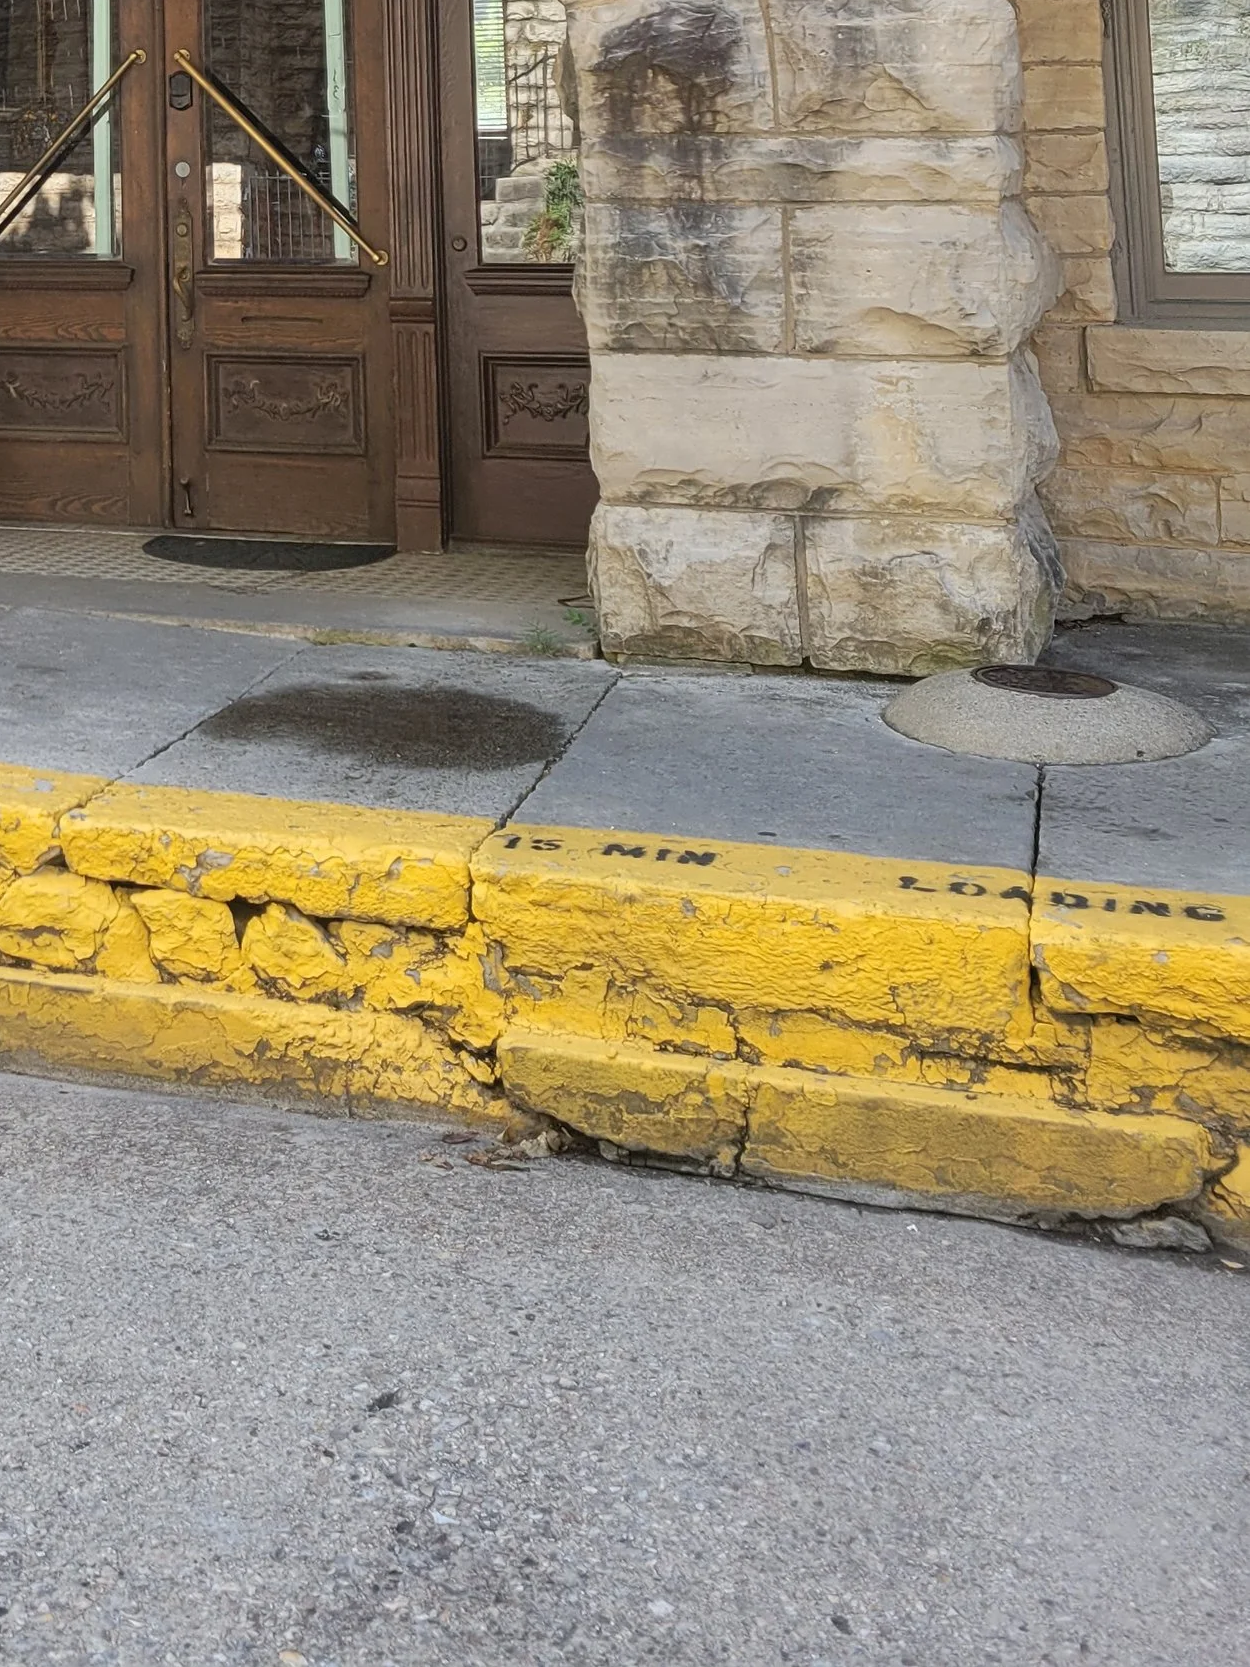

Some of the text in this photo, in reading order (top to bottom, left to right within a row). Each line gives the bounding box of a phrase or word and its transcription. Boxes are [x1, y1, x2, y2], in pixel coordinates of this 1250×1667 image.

[503, 834, 1228, 923] 15 MIN LOADING
